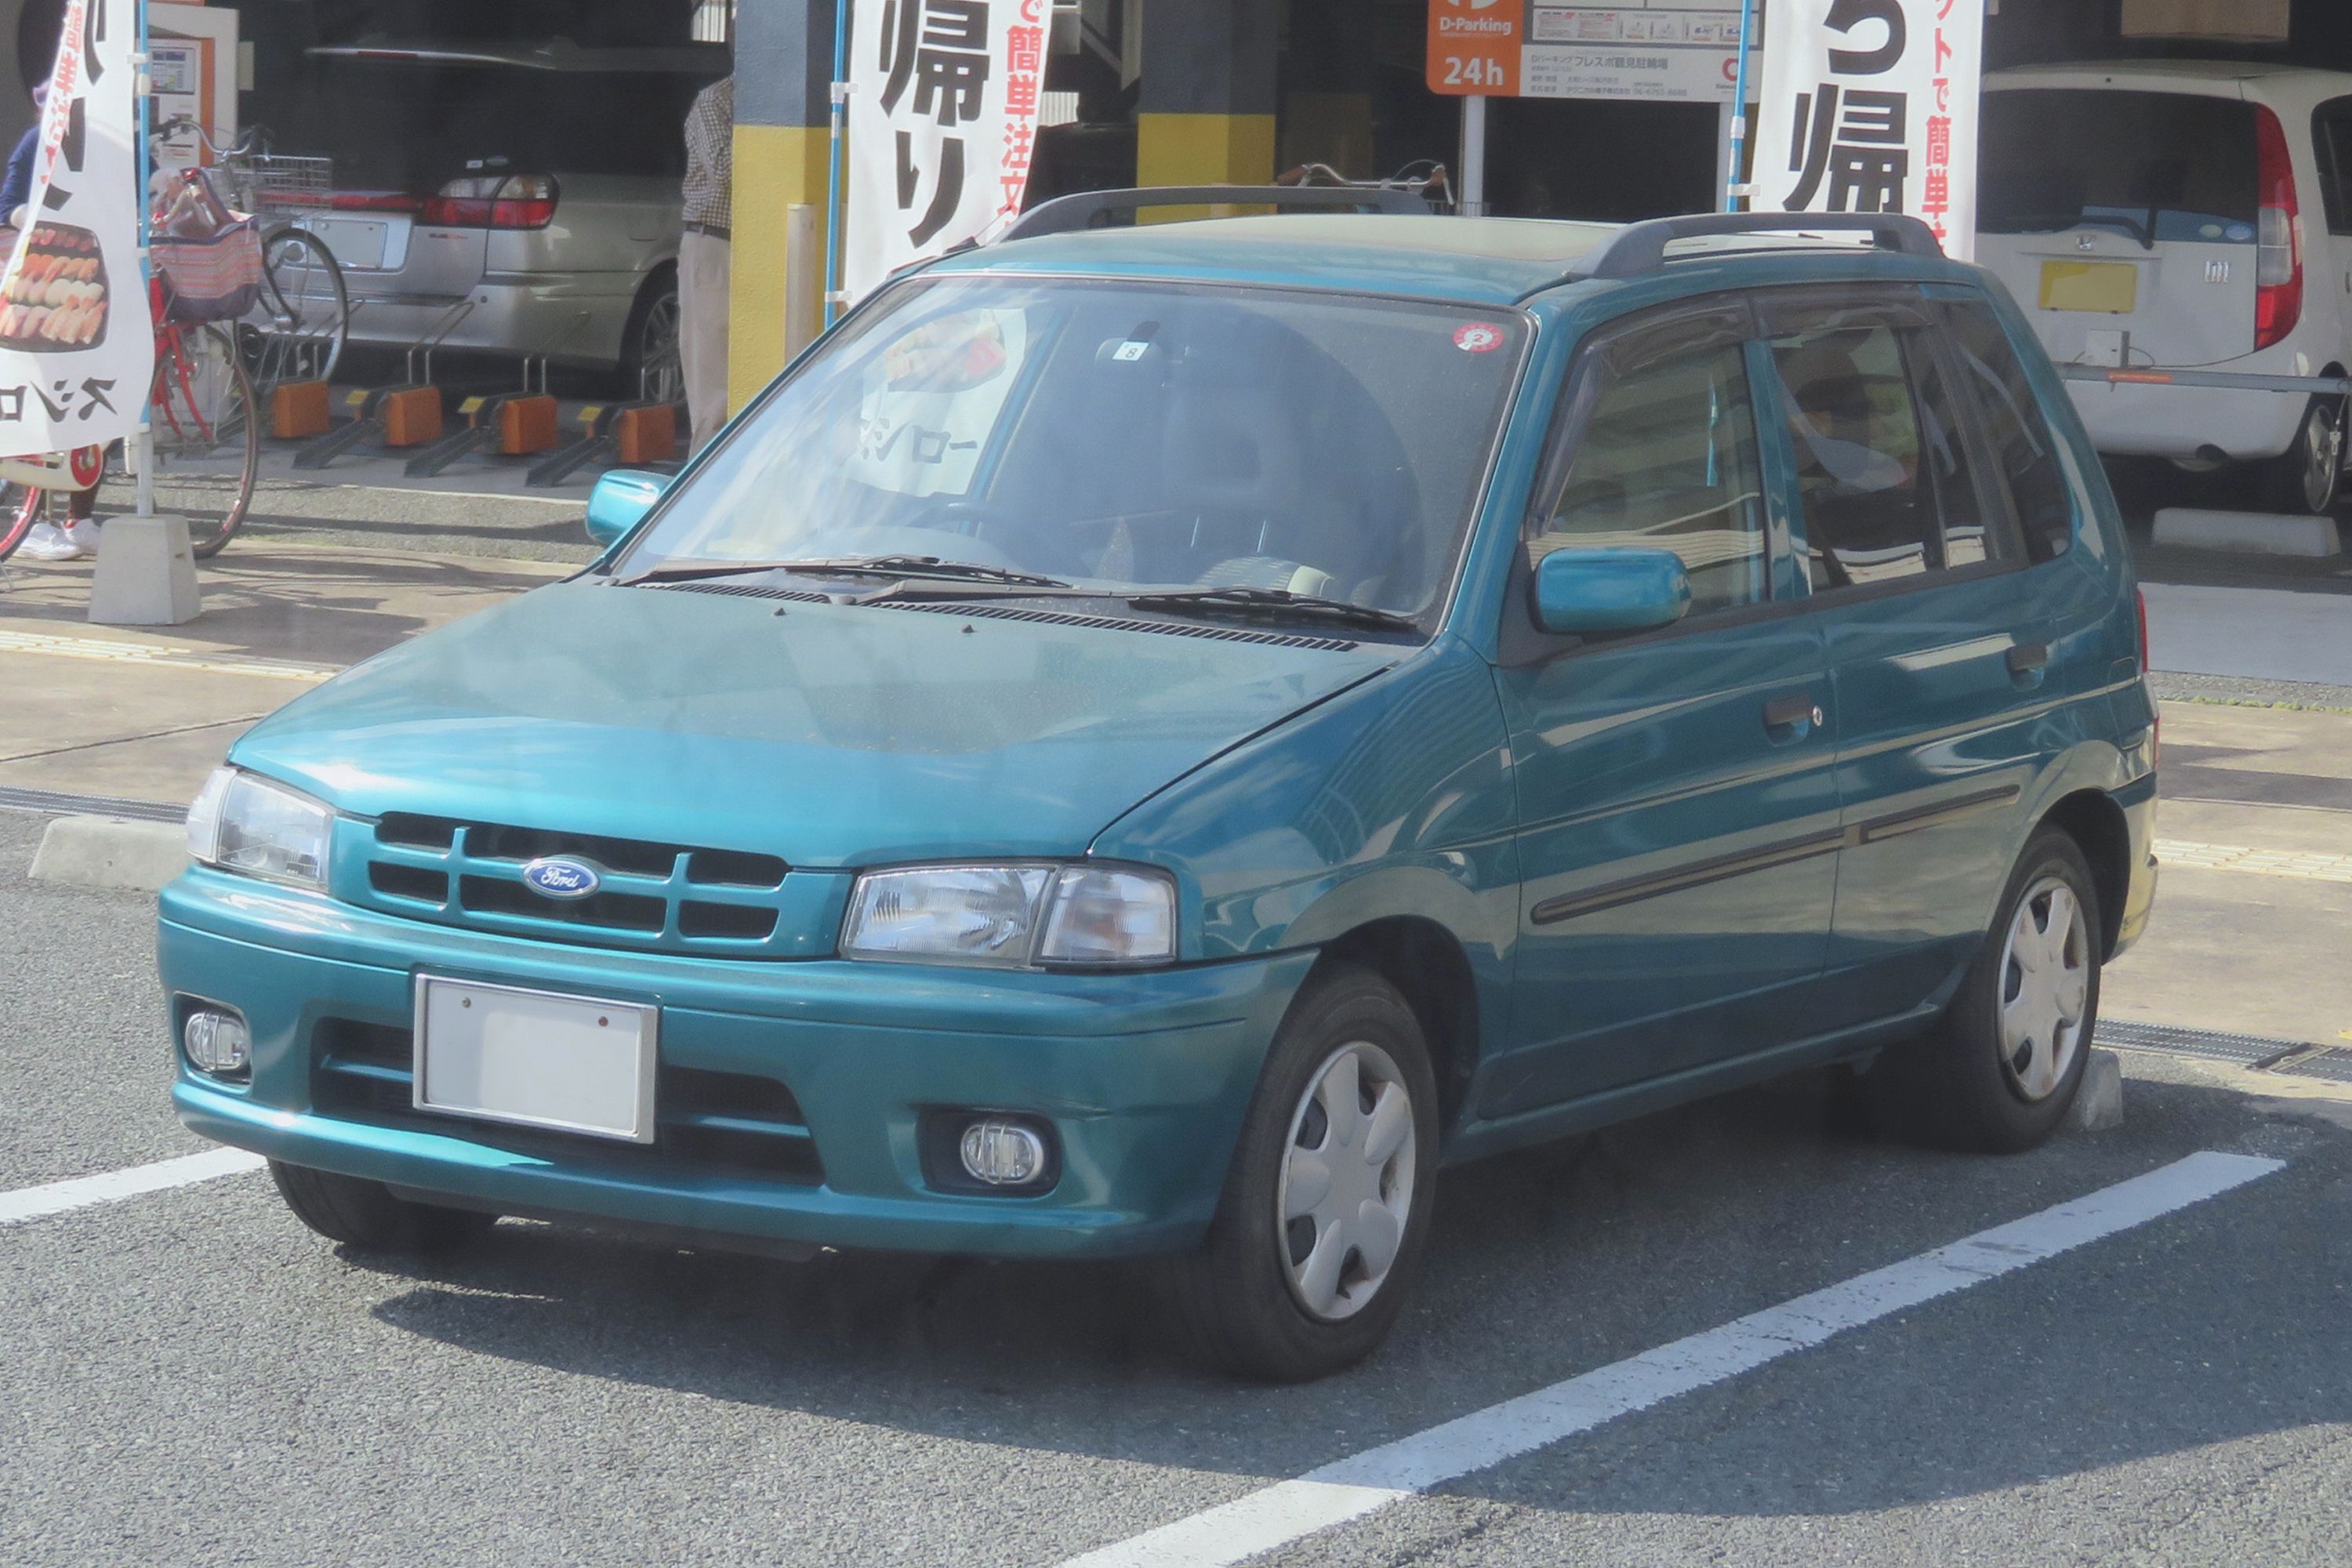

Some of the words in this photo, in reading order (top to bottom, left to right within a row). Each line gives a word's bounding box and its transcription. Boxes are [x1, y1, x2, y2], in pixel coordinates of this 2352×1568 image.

[1439, 16, 1512, 36] D-Parking
[997, 0, 1044, 227] で簡単注文
[1125, 347, 1139, 359] 8
[540, 866, 581, 888] Ford
